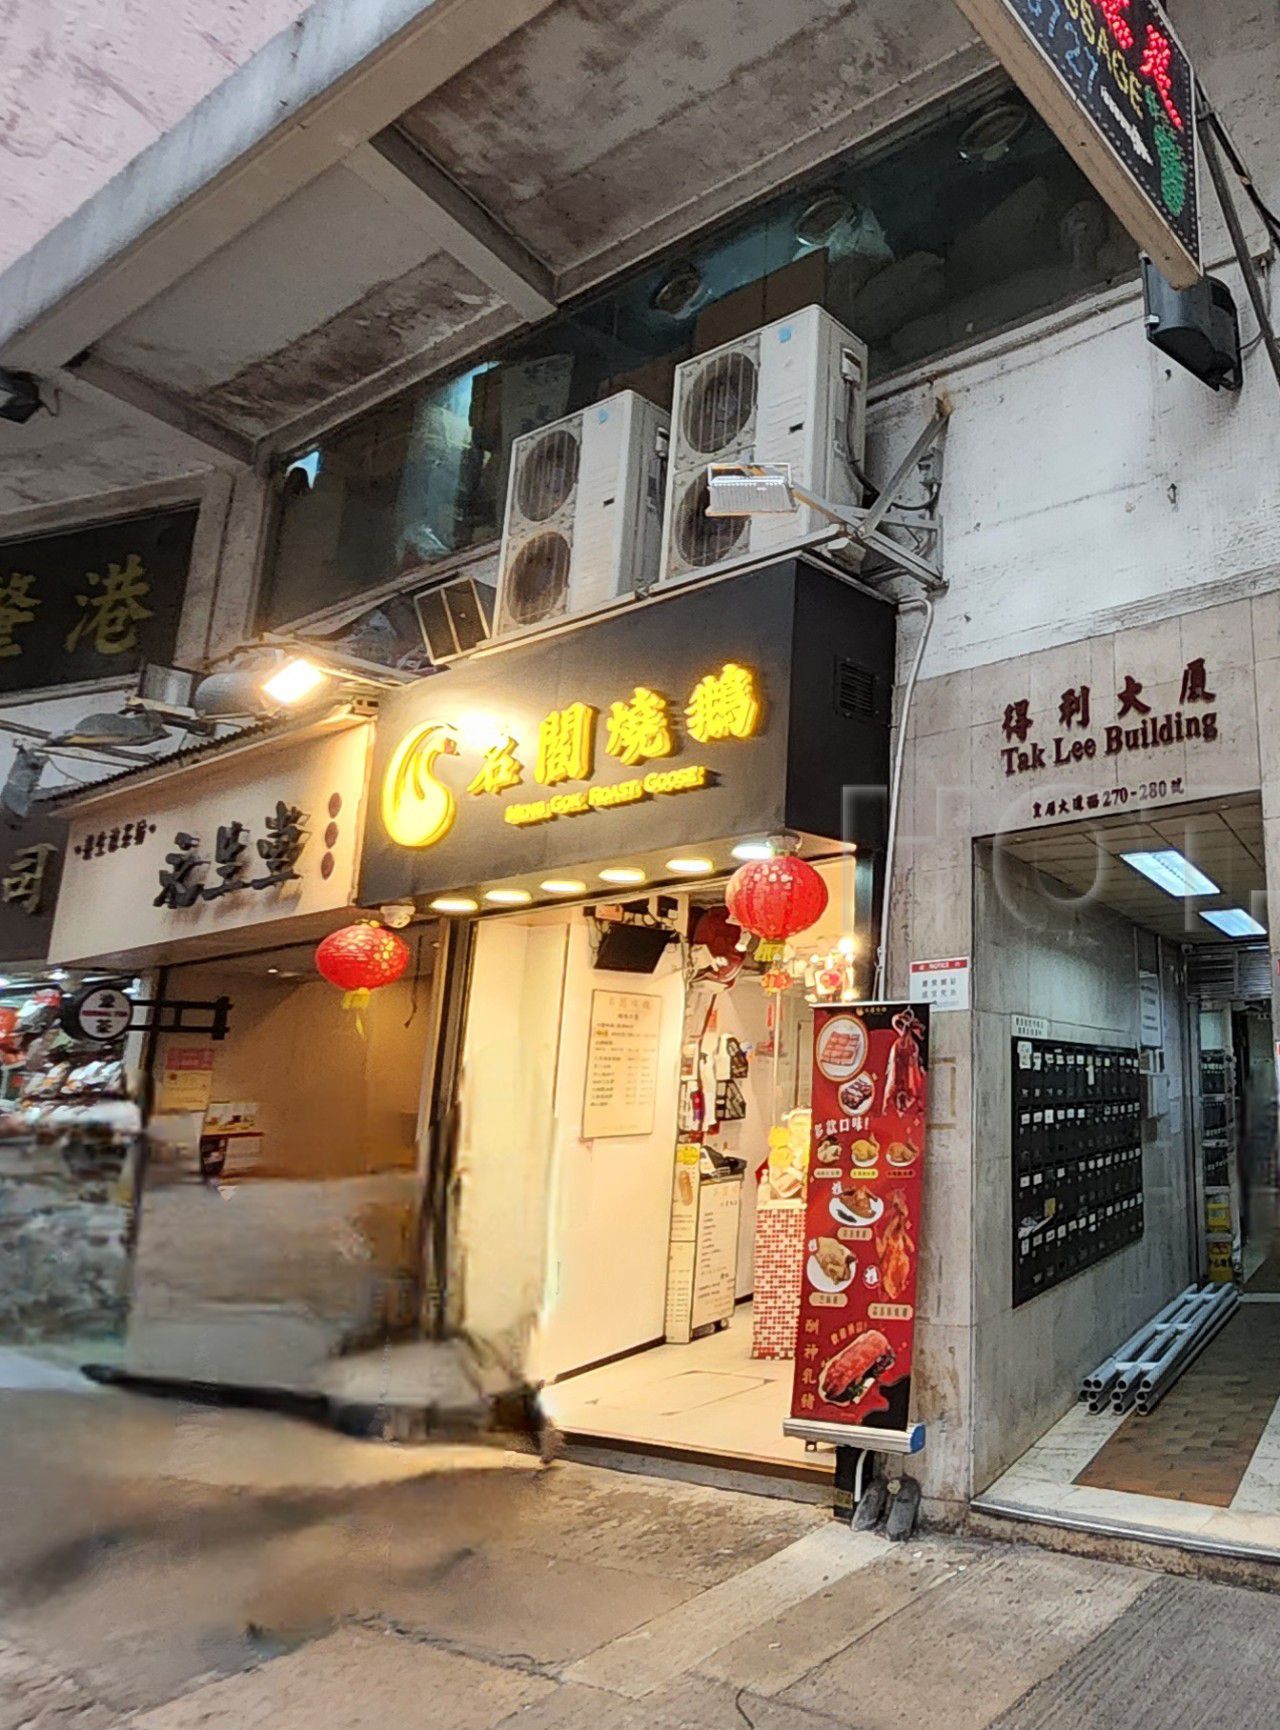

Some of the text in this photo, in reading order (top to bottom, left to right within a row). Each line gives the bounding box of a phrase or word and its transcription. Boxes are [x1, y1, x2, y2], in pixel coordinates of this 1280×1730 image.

[1001, 710, 1219, 778] Tak Lee Building
[588, 778, 643, 807] ROAST
[643, 765, 707, 794] GOOSE
